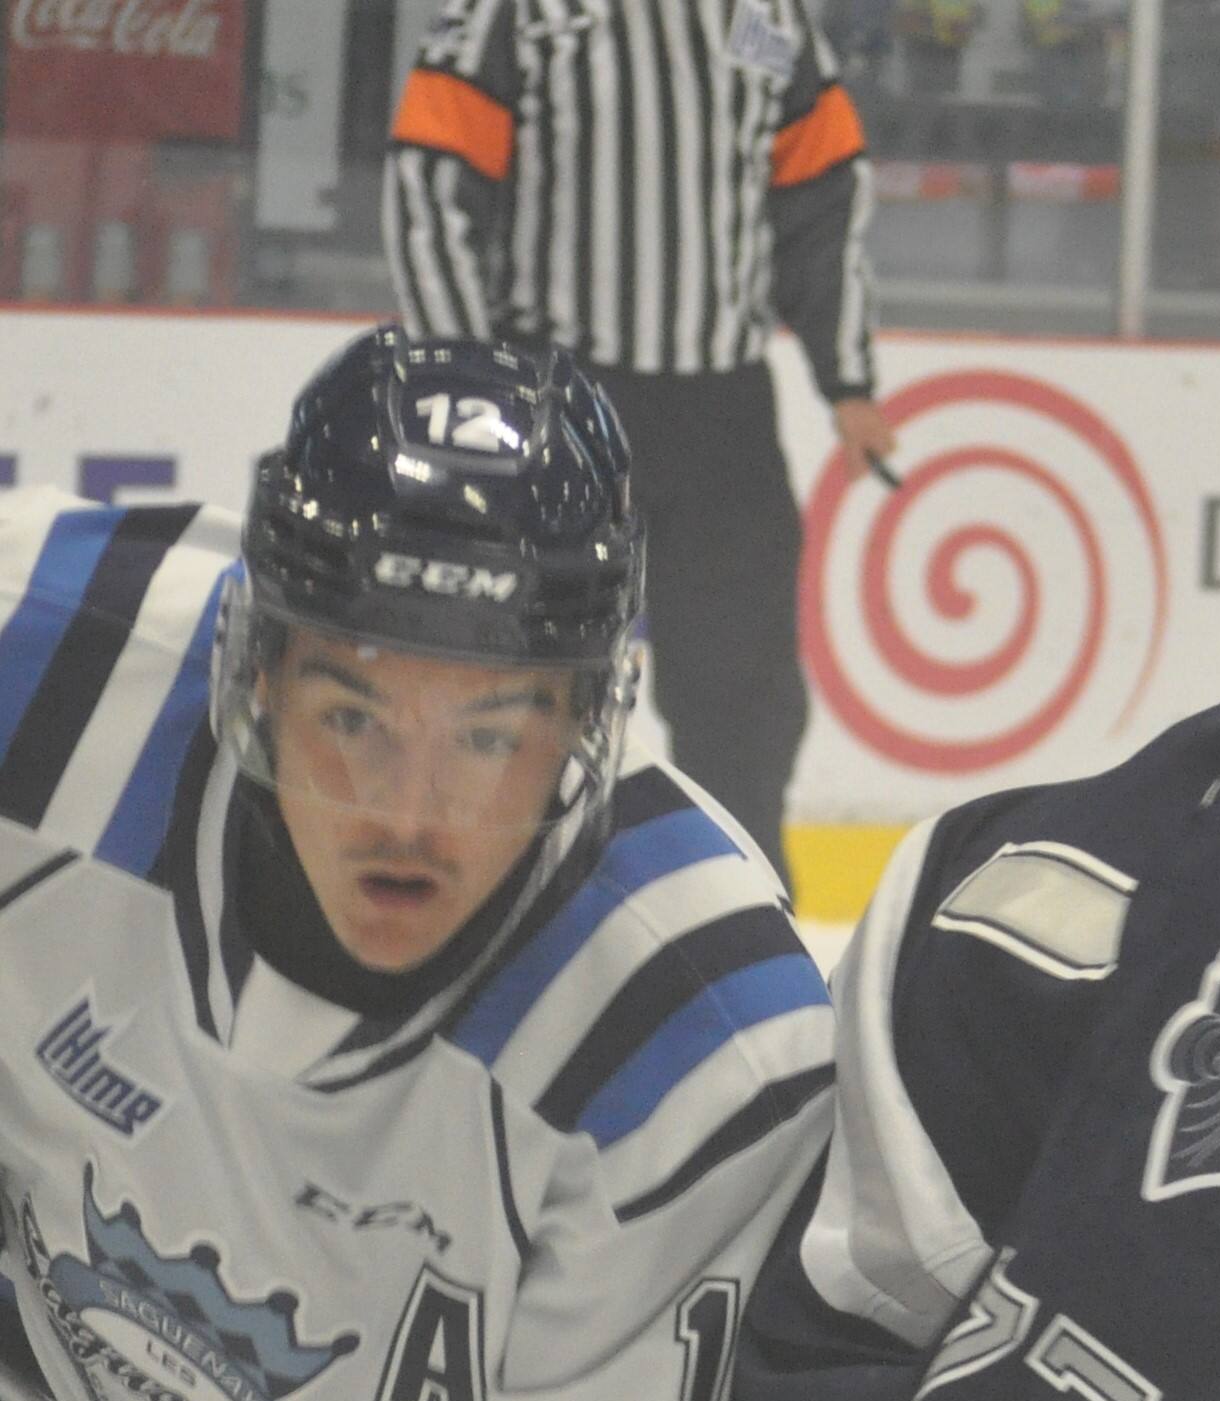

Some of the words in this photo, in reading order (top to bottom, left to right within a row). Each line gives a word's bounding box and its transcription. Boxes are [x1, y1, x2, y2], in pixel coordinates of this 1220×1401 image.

[415, 393, 520, 453] 12
[374, 552, 519, 602] CCM
[294, 1179, 453, 1255] CCM
[145, 1337, 198, 1388] LES
